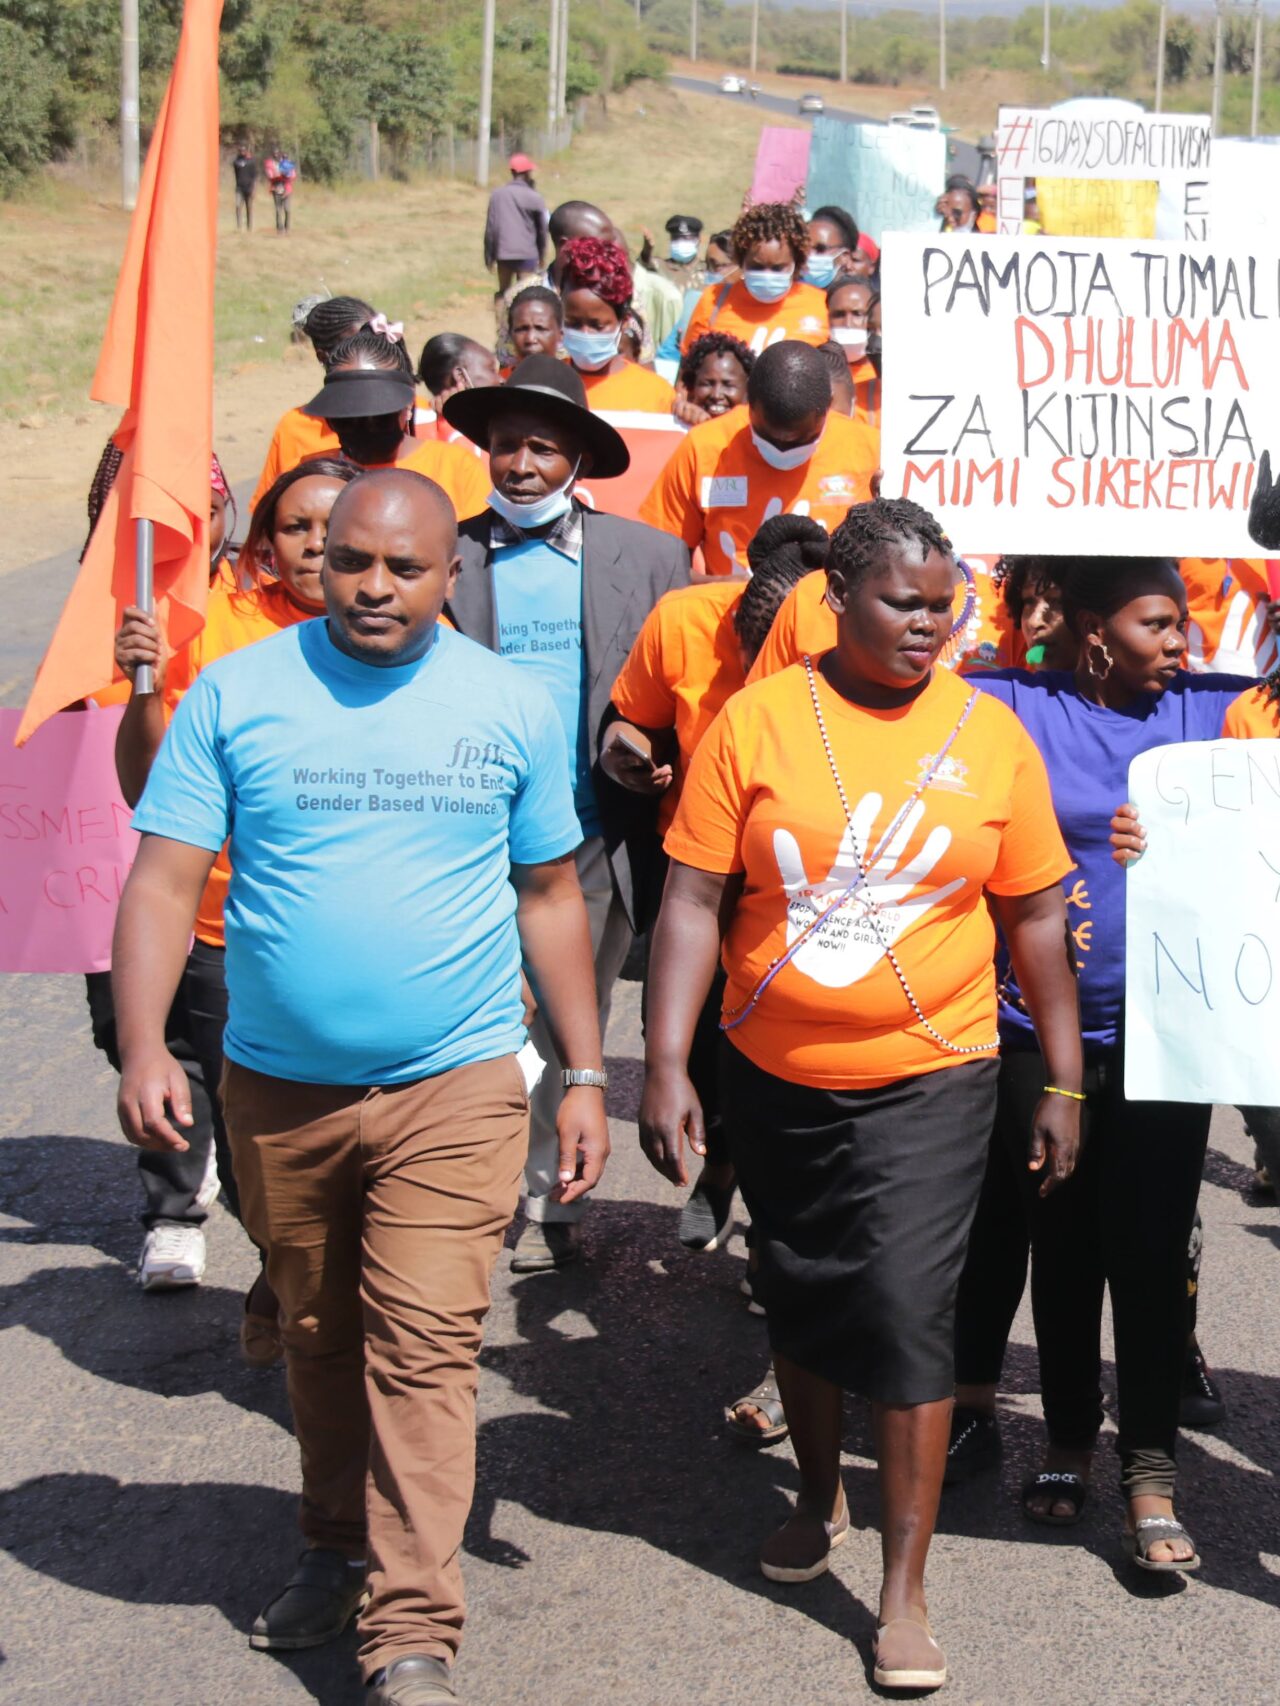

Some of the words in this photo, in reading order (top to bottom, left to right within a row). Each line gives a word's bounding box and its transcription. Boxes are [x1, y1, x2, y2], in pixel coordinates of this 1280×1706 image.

[998, 116, 1211, 169] #16DAYSOFACTIVISM
[923, 247, 1124, 316] PAMOJA
[1015, 315, 1250, 391] DHULUMA
[903, 394, 996, 458] ZA
[1022, 389, 1256, 460] KIJINSIA
[902, 457, 1020, 507] MIMI
[1046, 456, 1255, 510] SIKEKETWI
[530, 637, 571, 652] Based
[293, 768, 367, 789] Working
[373, 768, 453, 790] Together
[459, 773, 475, 788] to
[295, 794, 362, 811] Gender
[368, 794, 425, 812] Based
